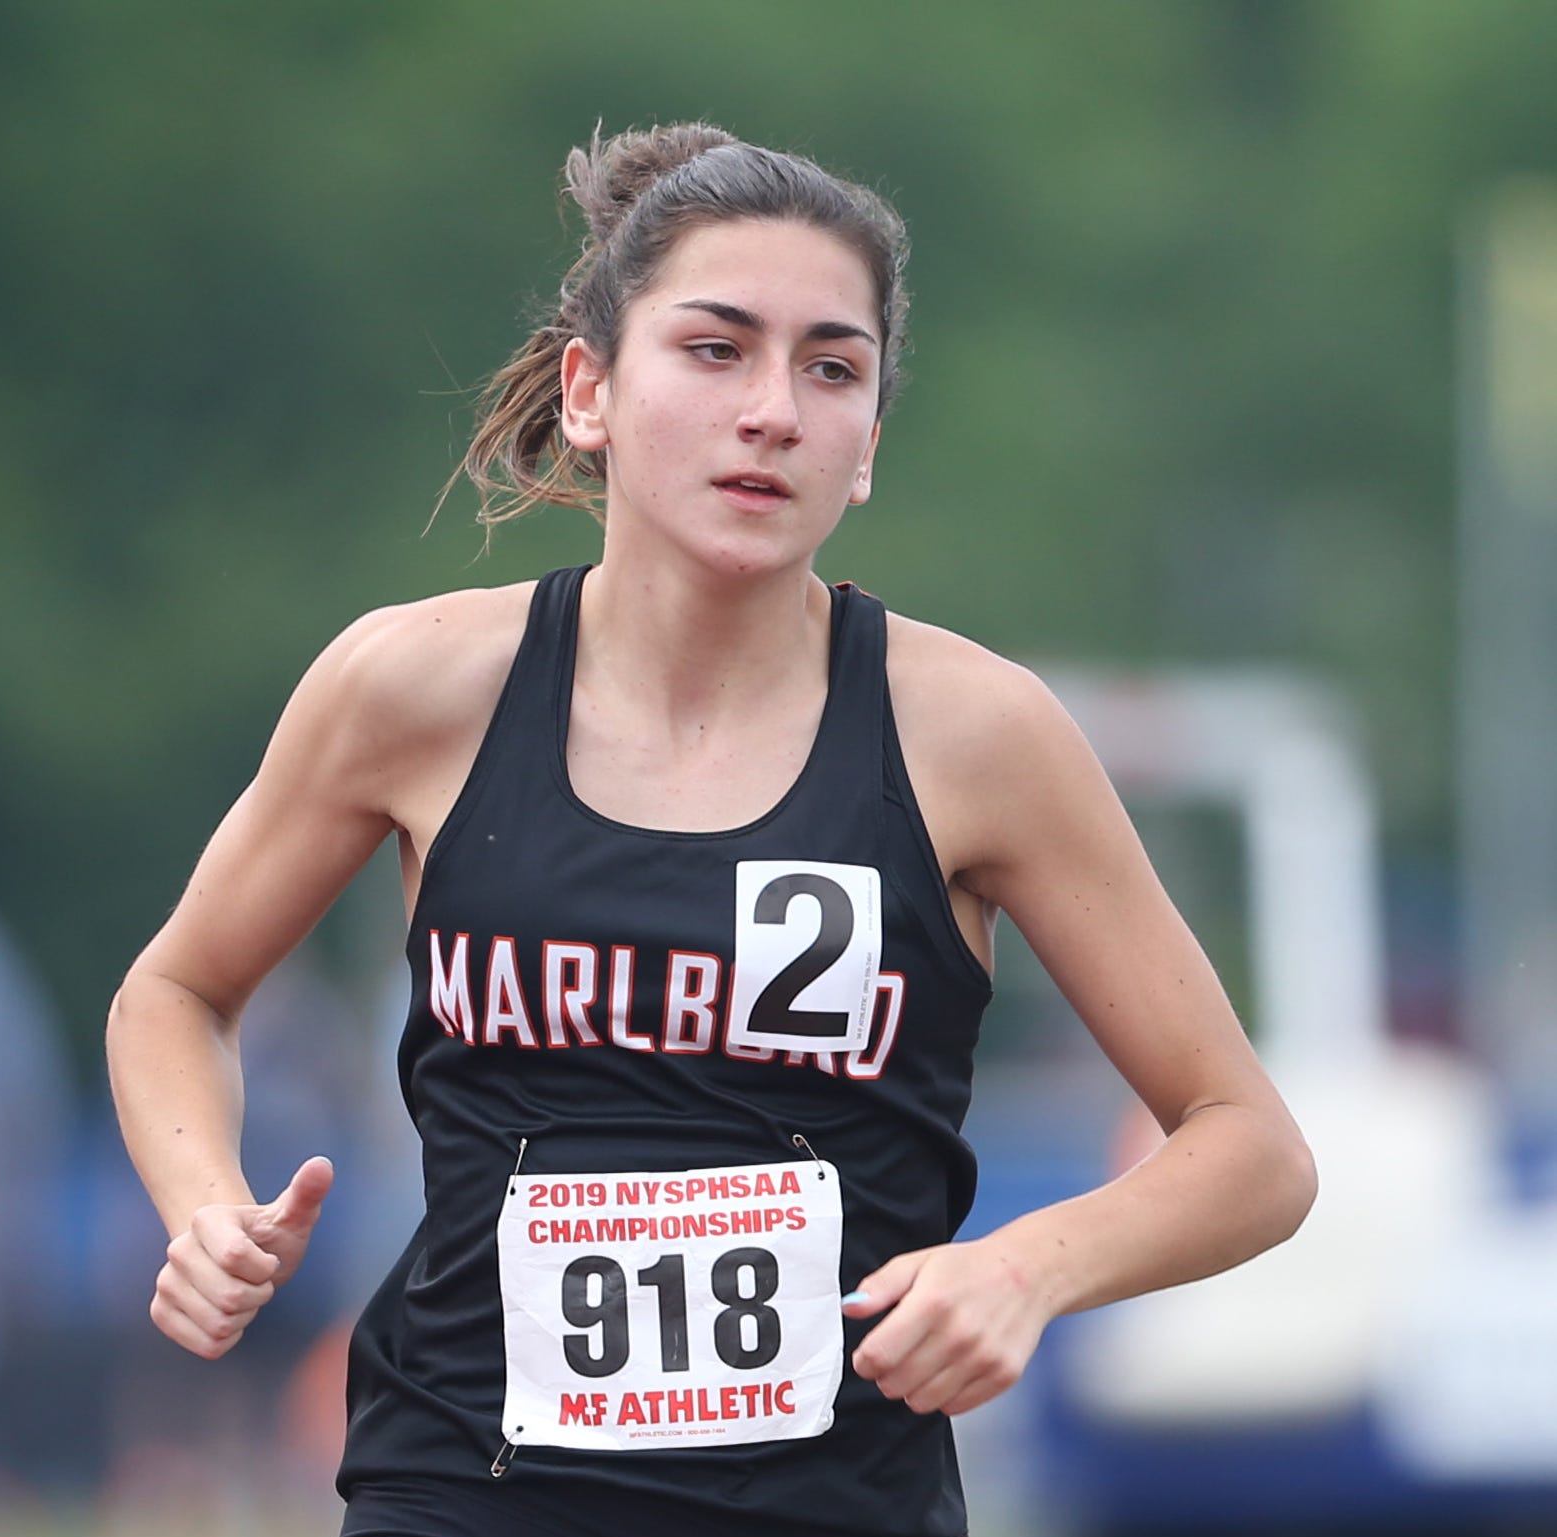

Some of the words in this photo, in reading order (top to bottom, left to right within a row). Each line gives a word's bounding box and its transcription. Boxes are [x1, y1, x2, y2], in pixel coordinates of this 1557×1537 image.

[746, 873, 855, 1038] 2
[430, 929, 906, 1080] MARLBO
[528, 1182, 608, 1208] 2019
[616, 1171, 801, 1205] NYSPHSAA
[528, 1206, 807, 1244] CHAMPIONSHIPS
[561, 1247, 782, 1378] 918
[617, 1380, 795, 1426] ATHLETIC
